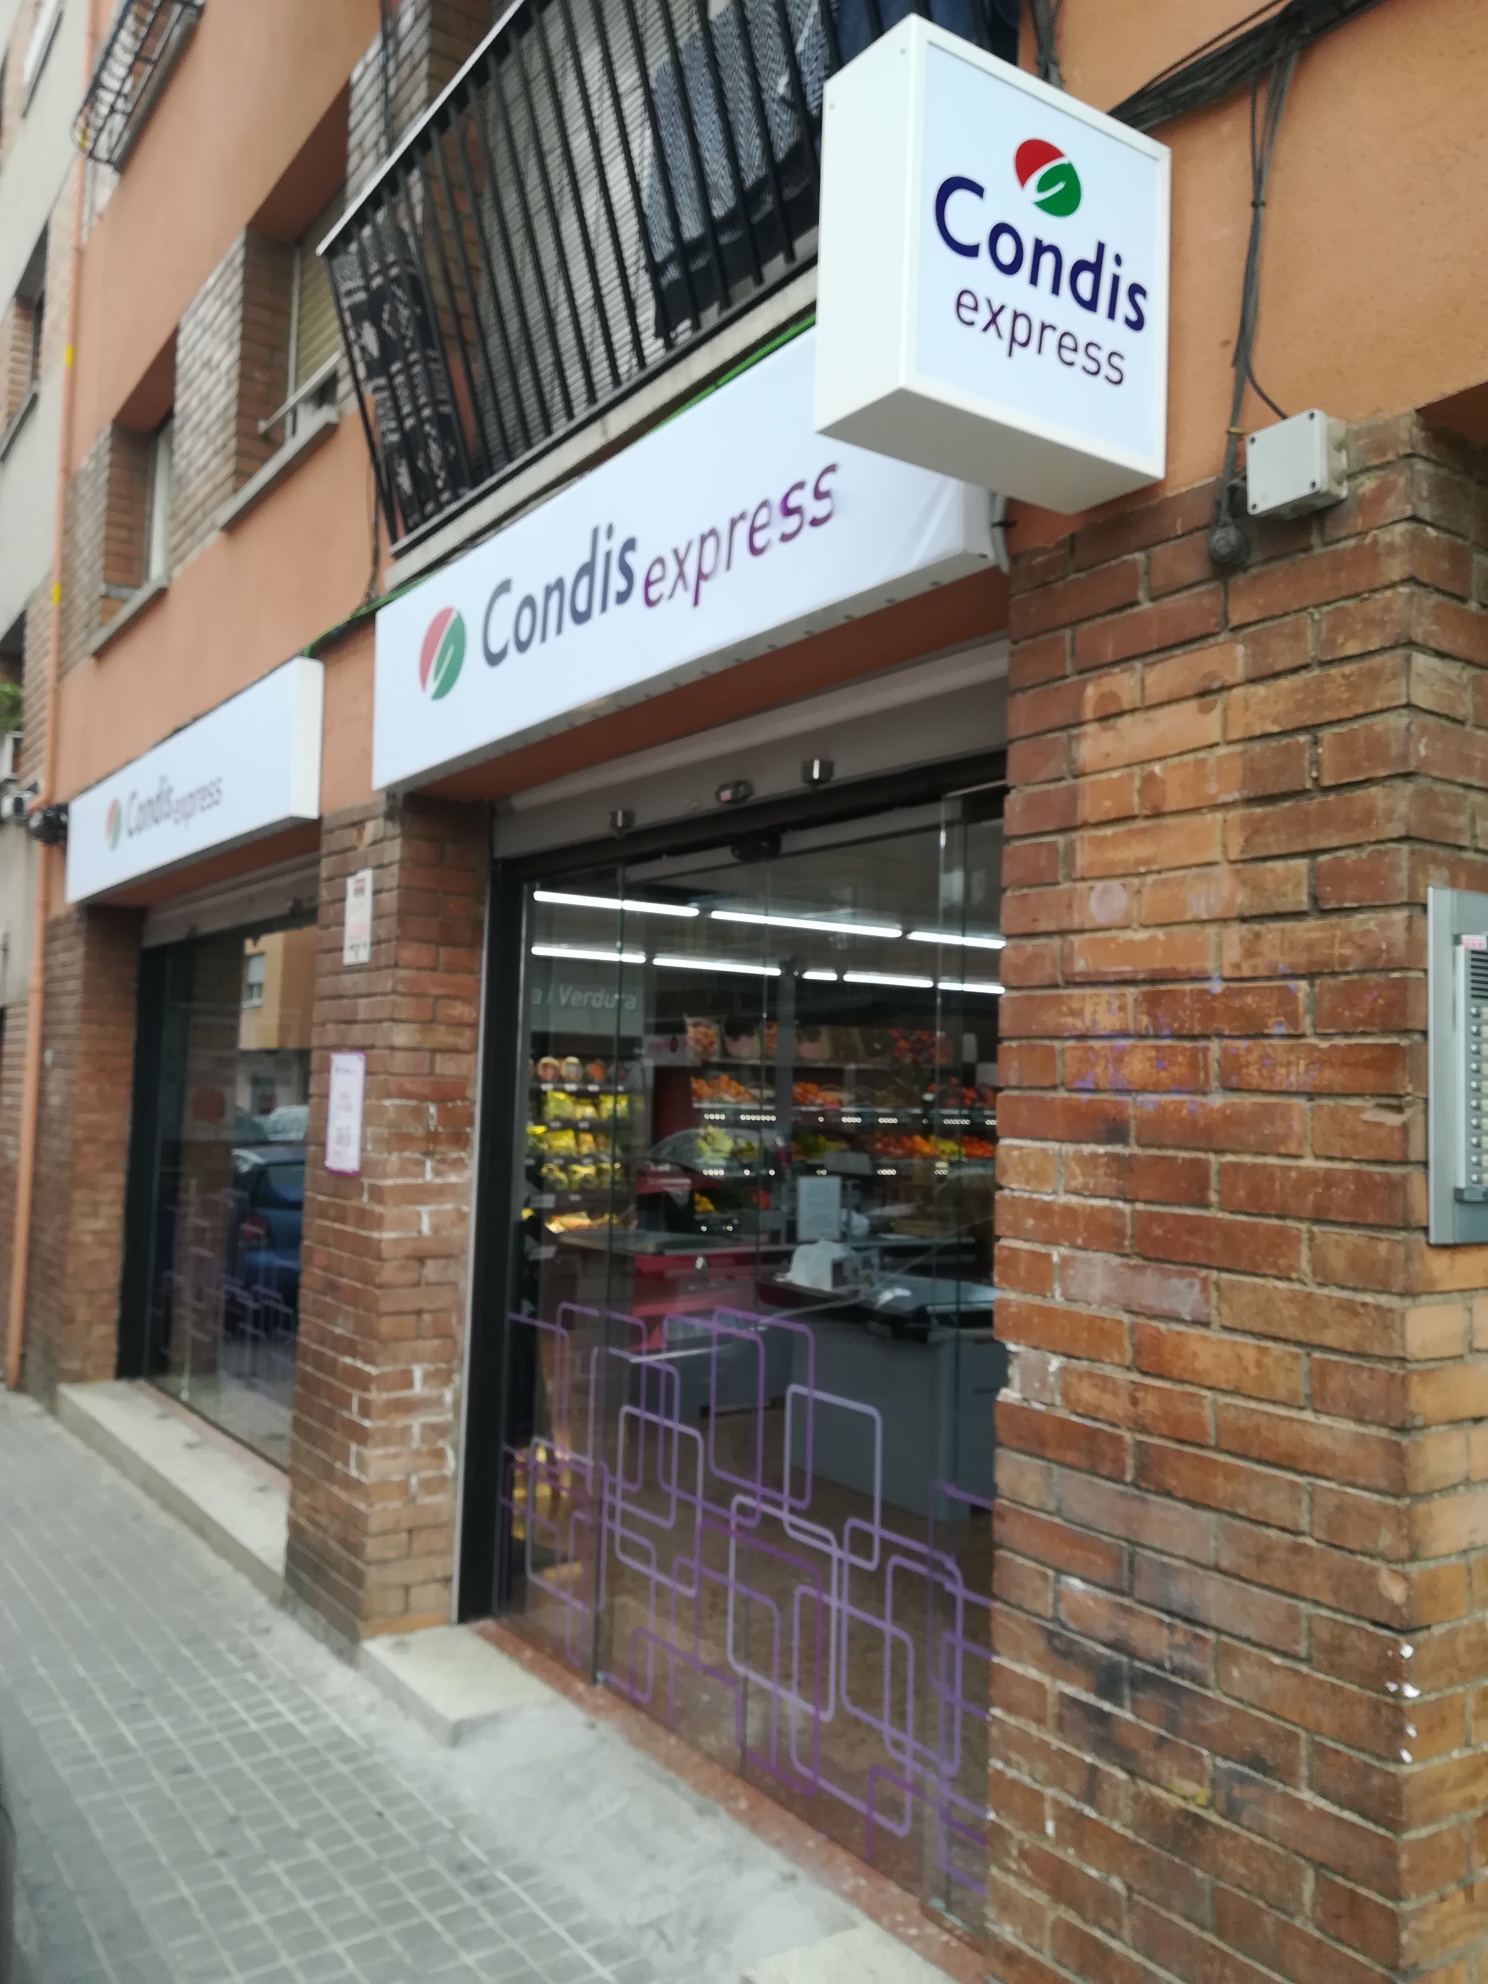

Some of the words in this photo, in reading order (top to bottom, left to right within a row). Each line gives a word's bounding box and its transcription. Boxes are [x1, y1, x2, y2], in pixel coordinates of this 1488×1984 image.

[935, 175, 1148, 332] Condis
[955, 288, 1126, 386] express
[481, 522, 638, 668] Condis
[643, 463, 840, 608] express
